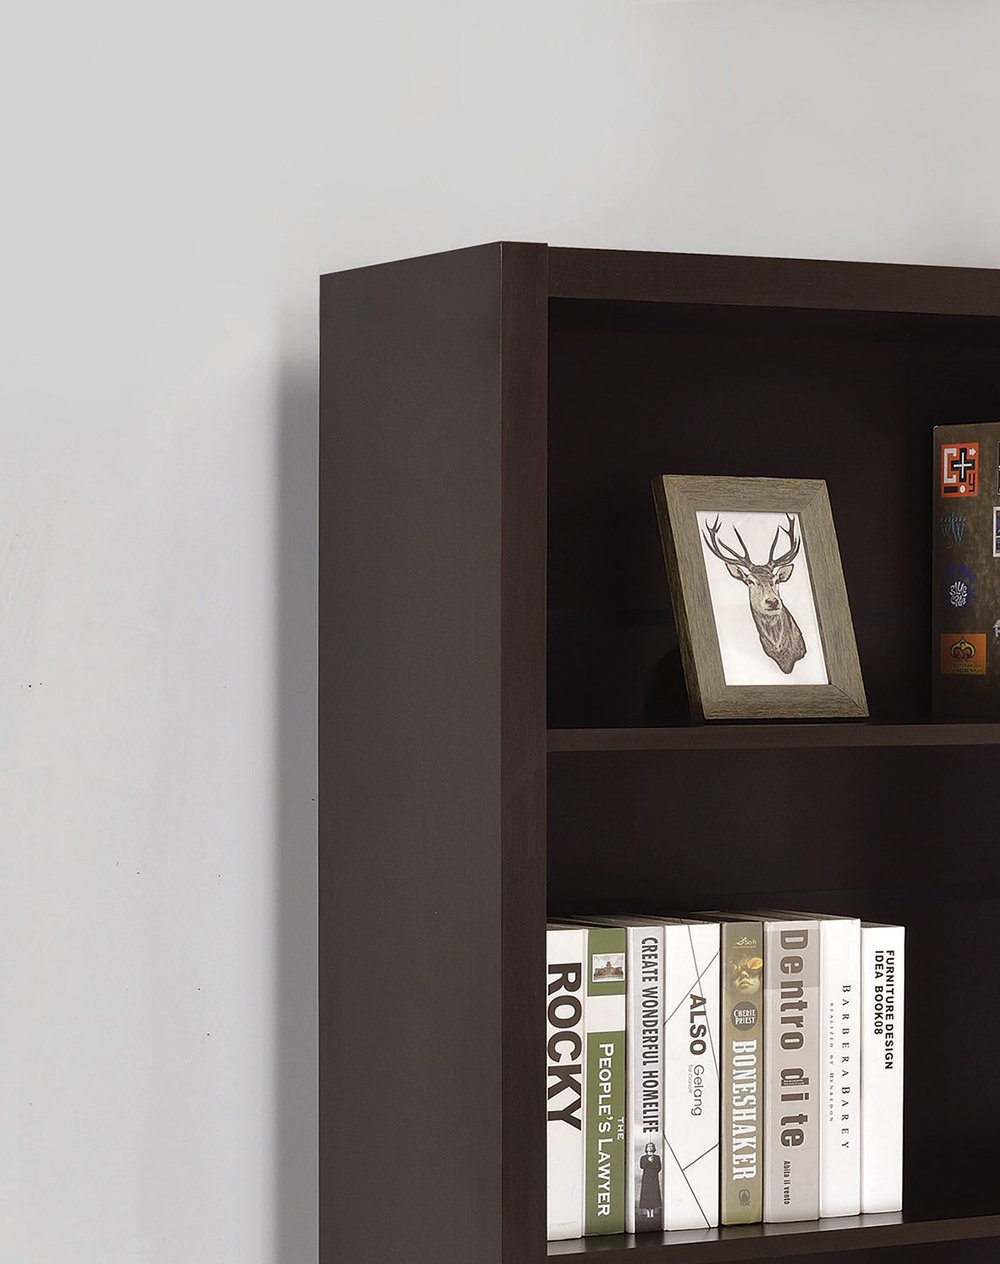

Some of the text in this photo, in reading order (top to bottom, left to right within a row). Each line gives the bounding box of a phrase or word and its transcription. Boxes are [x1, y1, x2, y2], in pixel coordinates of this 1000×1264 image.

[689, 993, 707, 1056] ALSO
[733, 1008, 756, 1018] CHERIE
[735, 1016, 756, 1025] PRIEST
[780, 929, 809, 1050] Dentro
[874, 950, 884, 1035] IDEA BOOK08
[884, 950, 895, 1070] FURNITURE DESIGN
[547, 962, 582, 1131] ROCKY
[641, 937, 659, 1133] CREATE WONDERFUL HOMELIFE
[597, 1043, 614, 1217] PEOPLE'S LAWYER
[617, 1116, 625, 1140] THE
[691, 1064, 705, 1116] Gelang
[732, 1040, 757, 1180] BONESHAKER
[841, 1086, 850, 1149] BAREY
